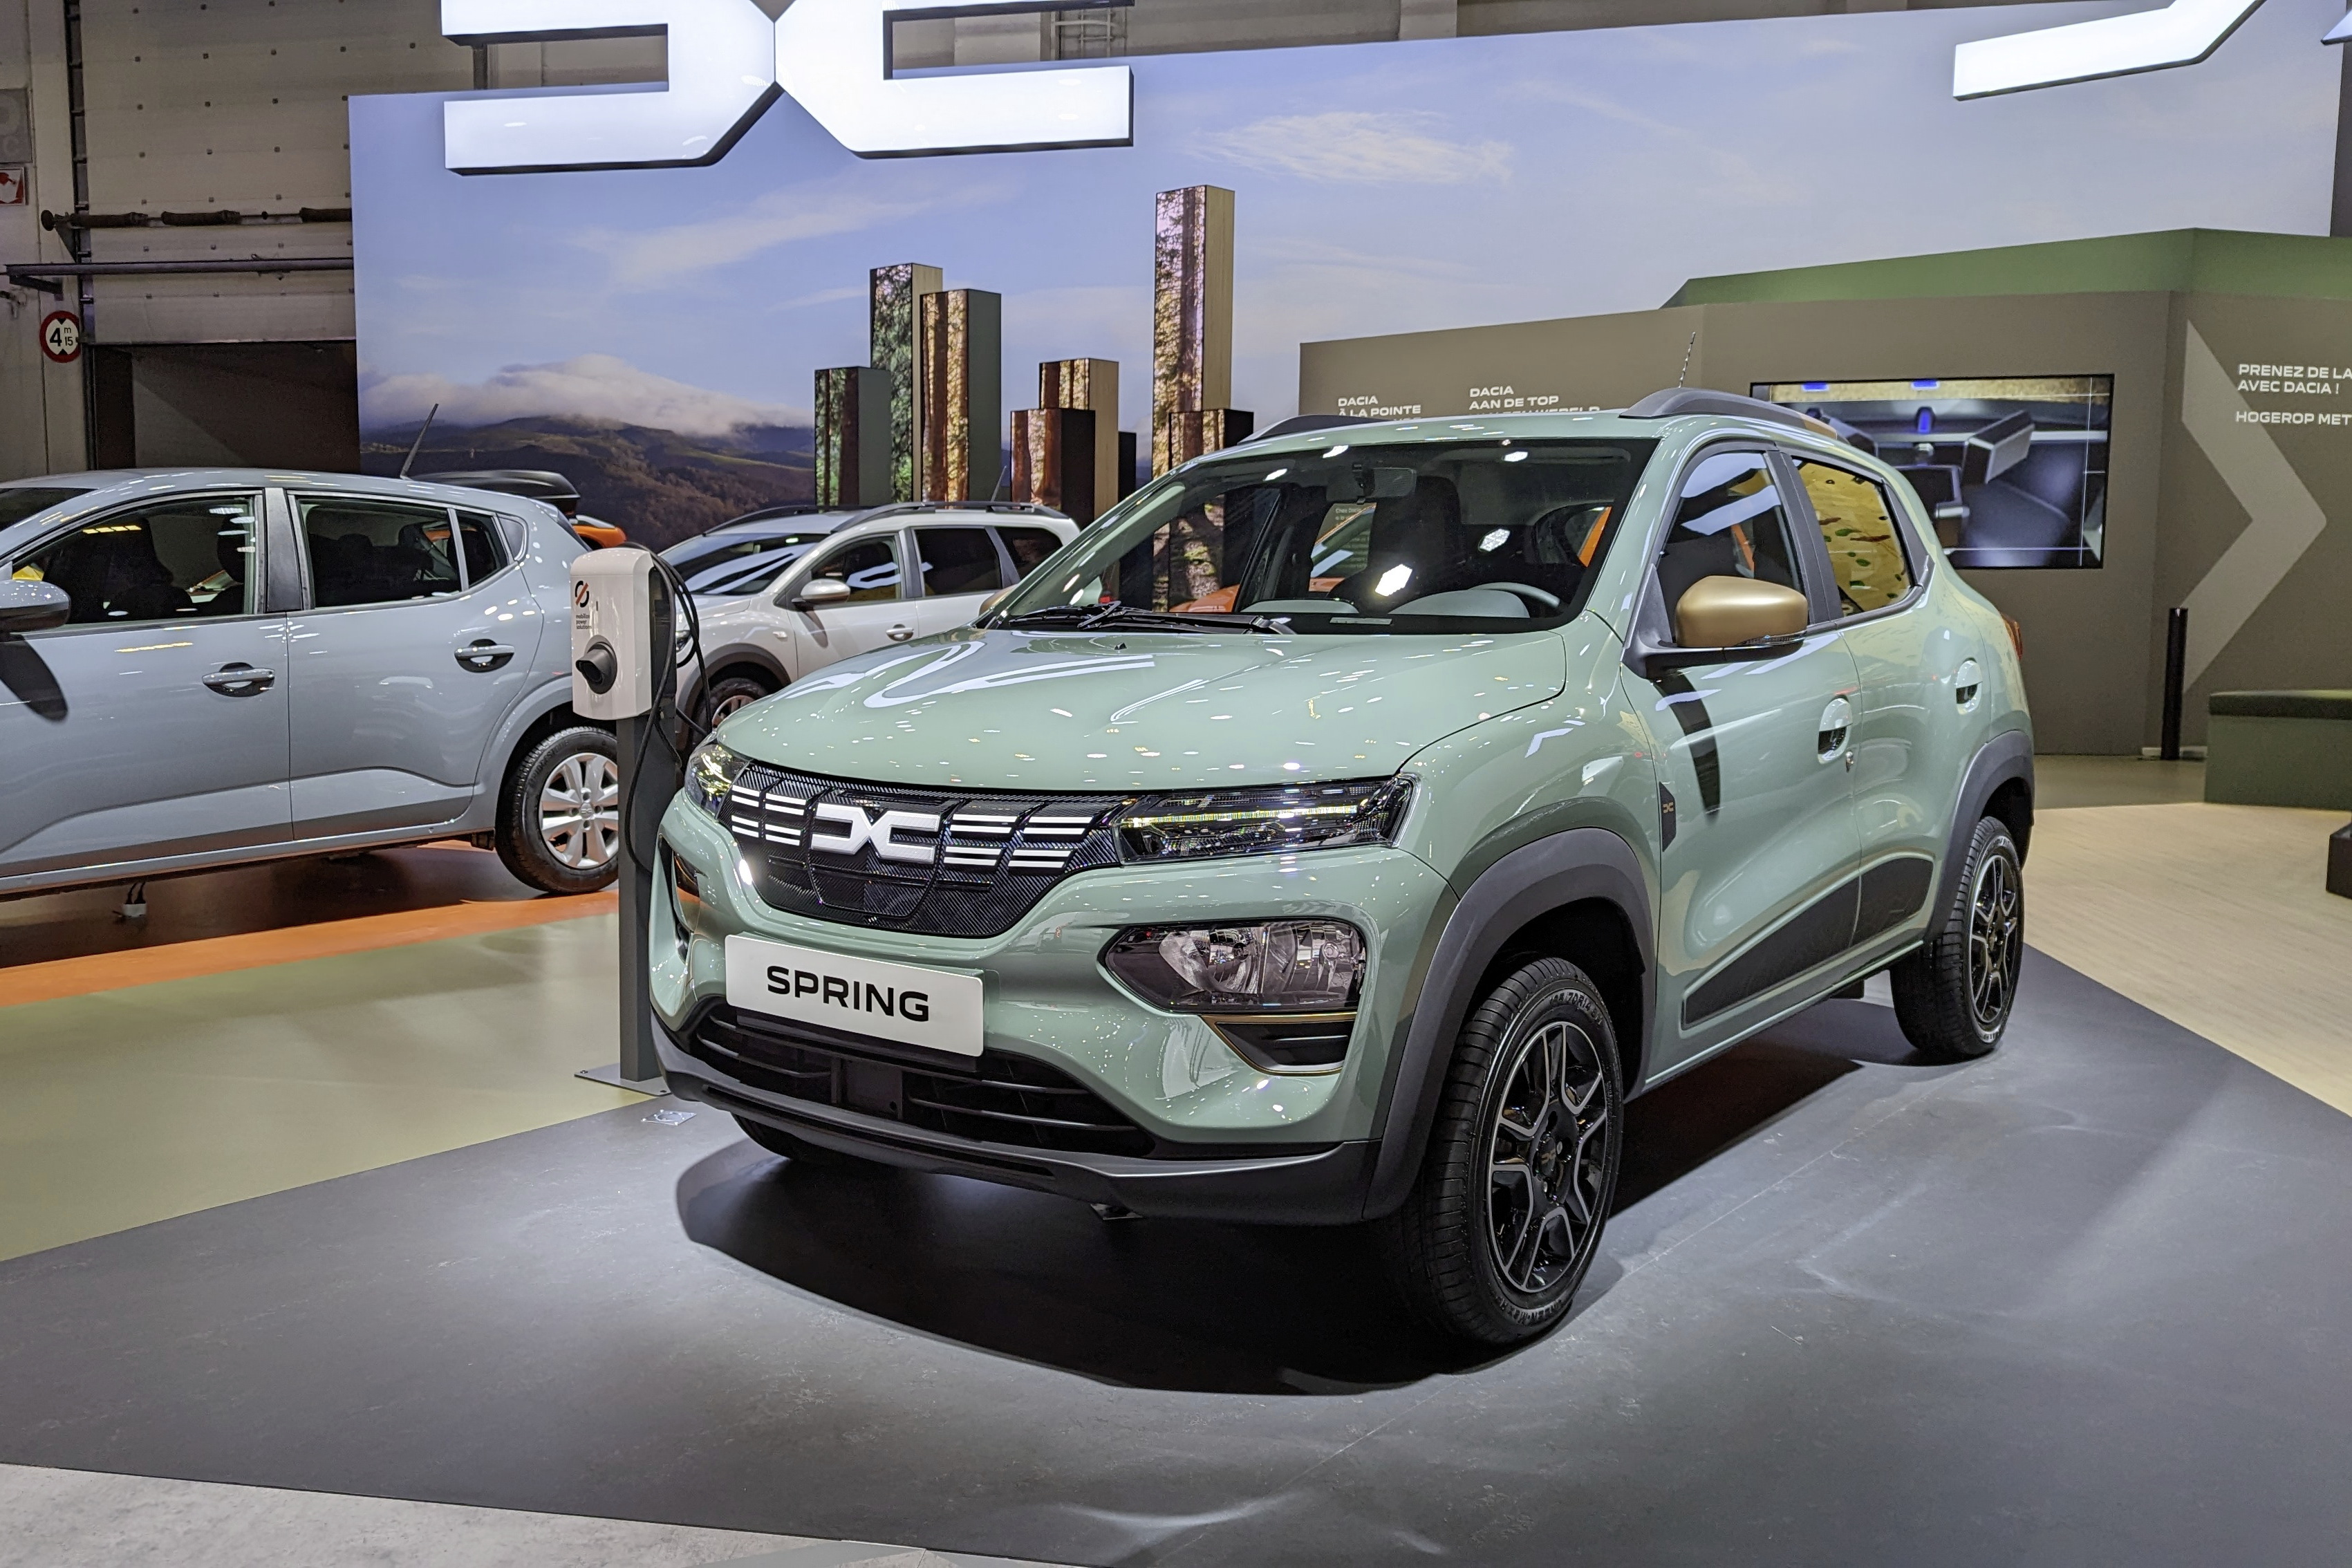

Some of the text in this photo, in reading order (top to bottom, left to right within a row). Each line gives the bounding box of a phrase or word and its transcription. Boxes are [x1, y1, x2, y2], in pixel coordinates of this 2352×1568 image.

[50, 327, 62, 346] 4
[64, 336, 73, 346] 15
[2239, 364, 2352, 380] PRENEZ DE LA
[1469, 385, 1514, 398] DACIA
[2237, 380, 2280, 392] AVEC
[2284, 382, 2332, 394] DACIA
[1338, 395, 1379, 407] DACIA
[1468, 399, 1501, 410] AAN
[1504, 397, 1524, 408] DE
[1527, 395, 1559, 406] TOP
[1350, 409, 1368, 418] LA
[1370, 404, 1421, 417] POINTE
[2235, 411, 2352, 426] HOGEROP MET
[767, 965, 930, 1023] SPRING
